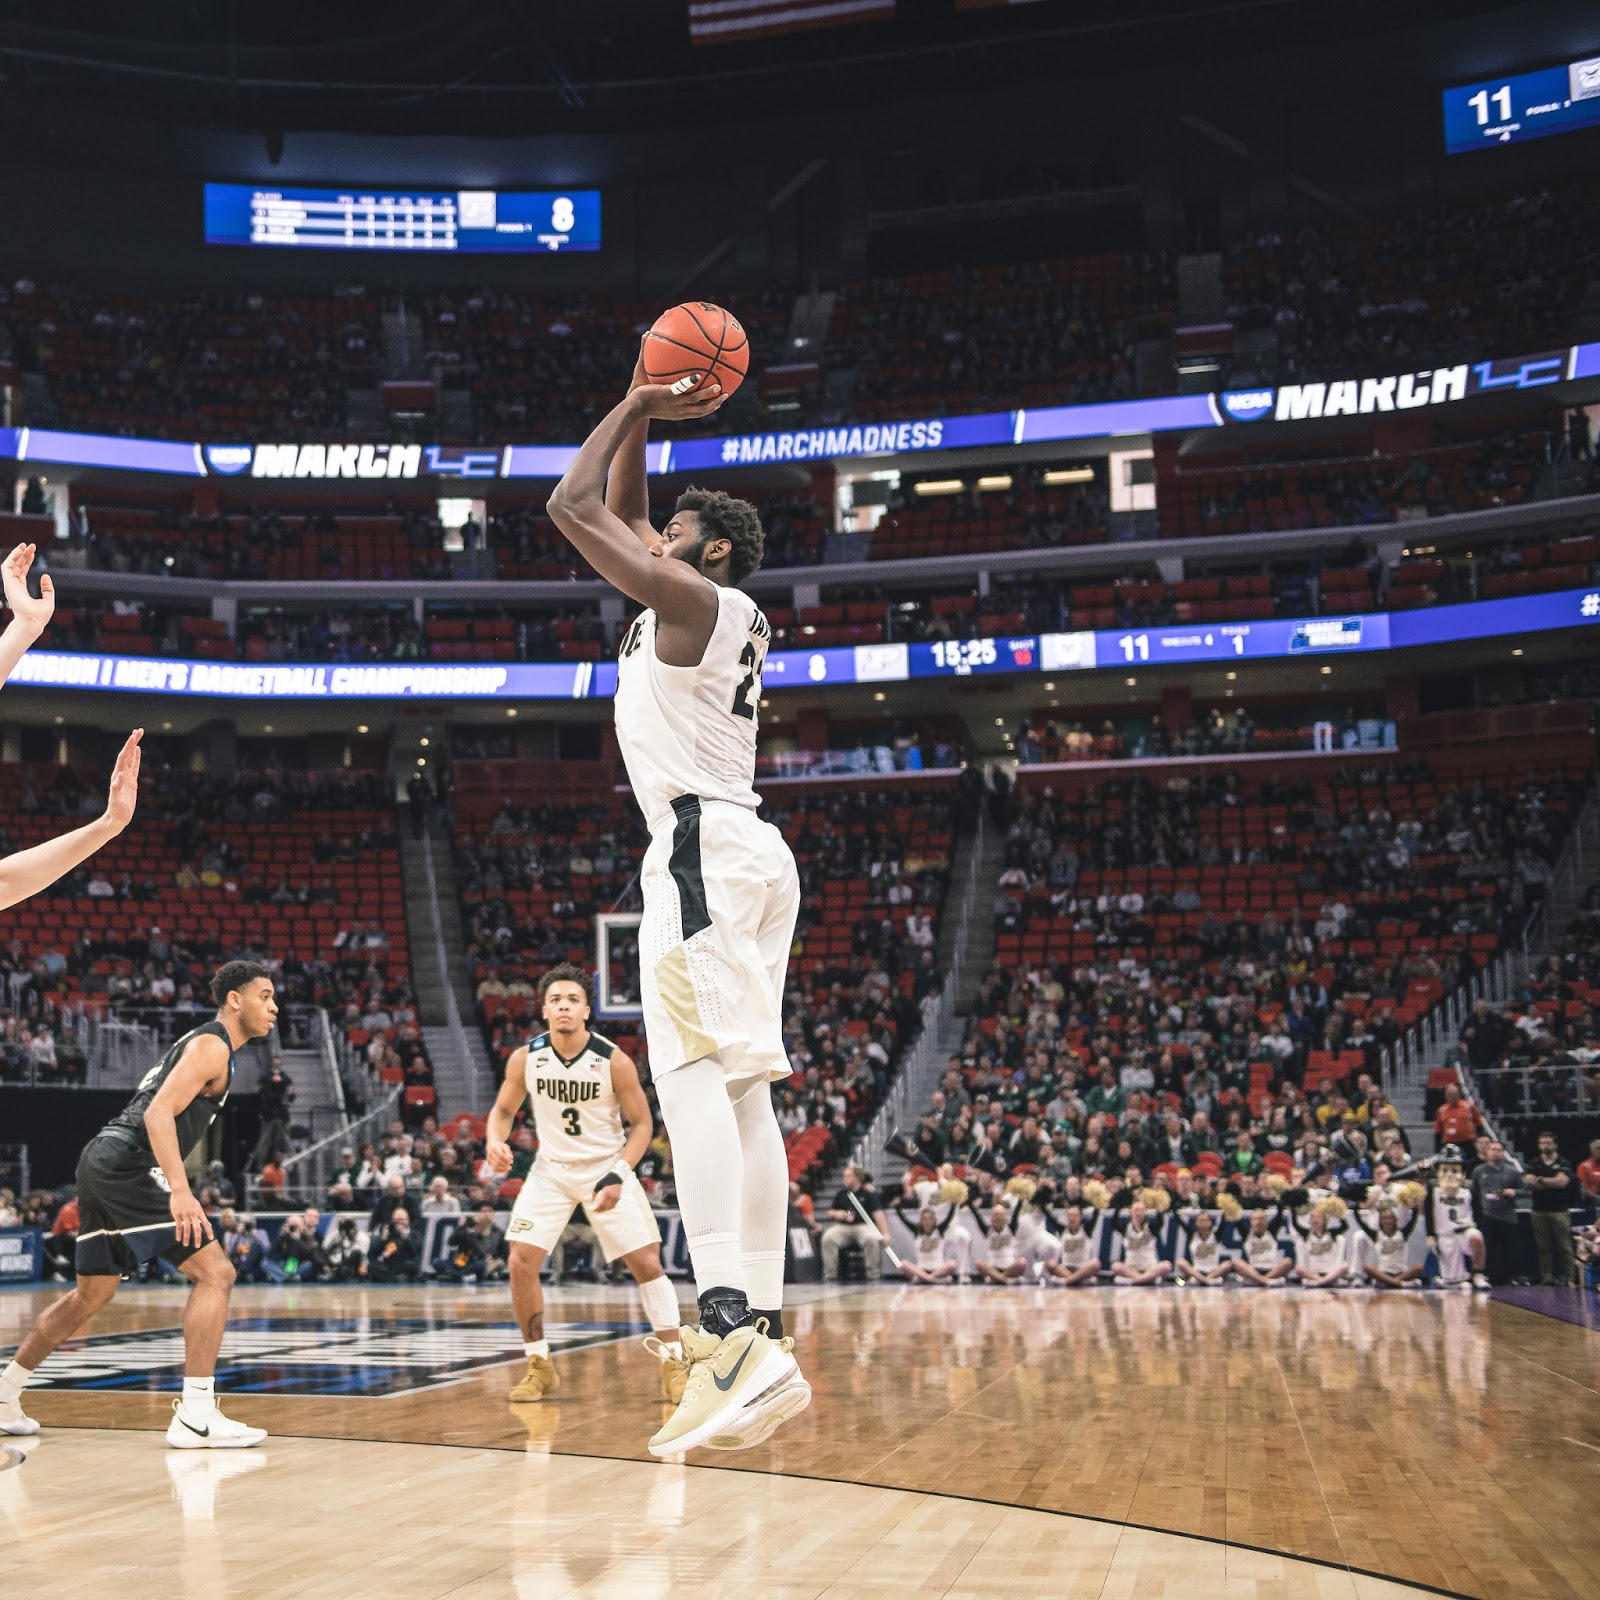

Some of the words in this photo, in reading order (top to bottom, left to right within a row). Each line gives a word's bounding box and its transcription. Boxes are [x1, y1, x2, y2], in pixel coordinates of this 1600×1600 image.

[1468, 85, 1511, 125] 11
[551, 197, 575, 233] 8
[721, 421, 943, 463] #MARCHMADNESS
[930, 637, 998, 668] 15:25
[1118, 633, 1150, 661] 11
[114, 659, 189, 690] MEN'S
[190, 664, 328, 695] BASKETBALL
[330, 667, 508, 695] CHAMPIONSHIP
[731, 640, 763, 721] 2
[808, 653, 827, 682] 8
[536, 1078, 601, 1104] PURDUE
[561, 1107, 582, 1137] 3
